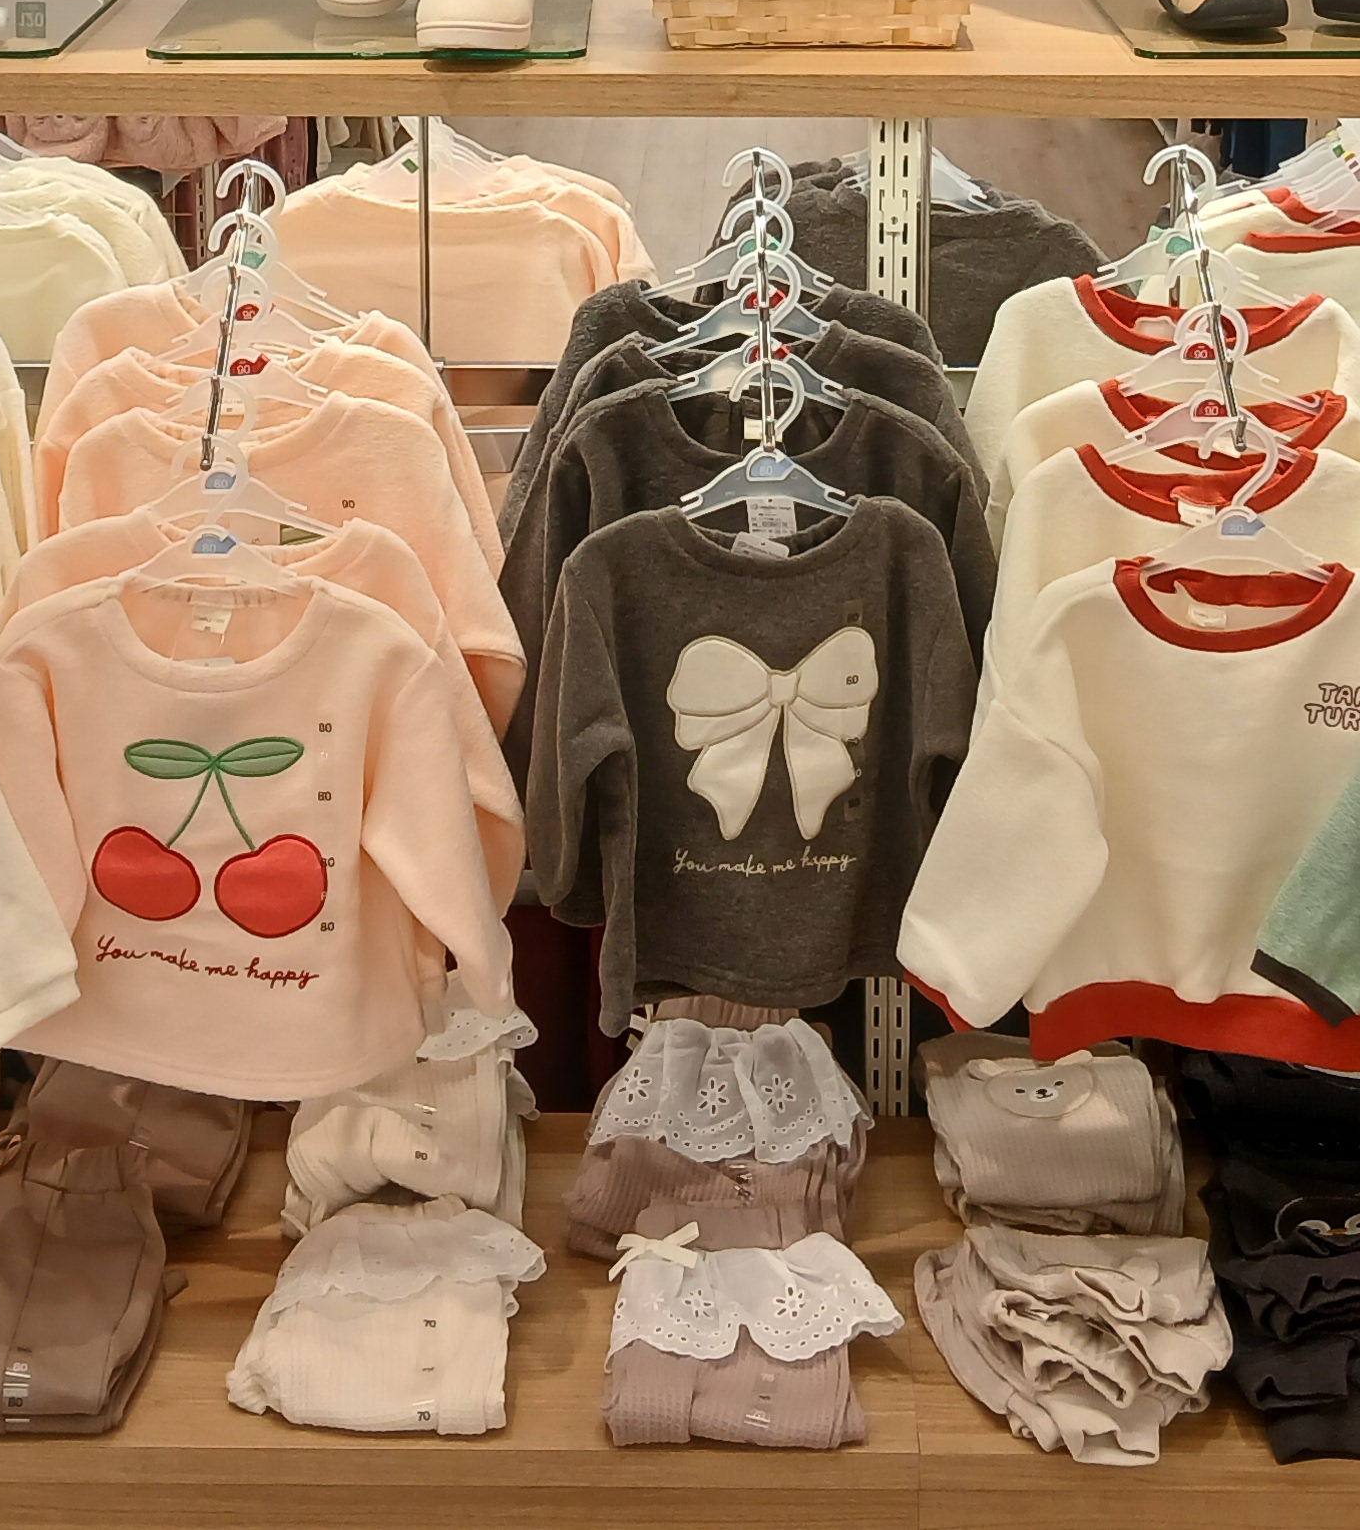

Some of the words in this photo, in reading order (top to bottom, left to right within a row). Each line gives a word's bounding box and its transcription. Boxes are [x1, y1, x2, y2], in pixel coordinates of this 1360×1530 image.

[1194, 351, 1208, 360] 90
[237, 365, 250, 375] 90
[1204, 406, 1218, 416] 90
[213, 478, 228, 489] 80
[202, 543, 217, 553] 80
[317, 791, 332, 801] 80
[673, 847, 717, 874] You
[718, 854, 766, 877] make
[772, 859, 796, 874] me
[800, 845, 857, 873] happy
[320, 921, 335, 931] 80
[96, 934, 148, 961] You
[151, 948, 199, 972] make
[205, 964, 238, 976] me
[245, 957, 320, 990] happy
[423, 1319, 436, 1328] 70
[417, 1411, 431, 1421] 70
